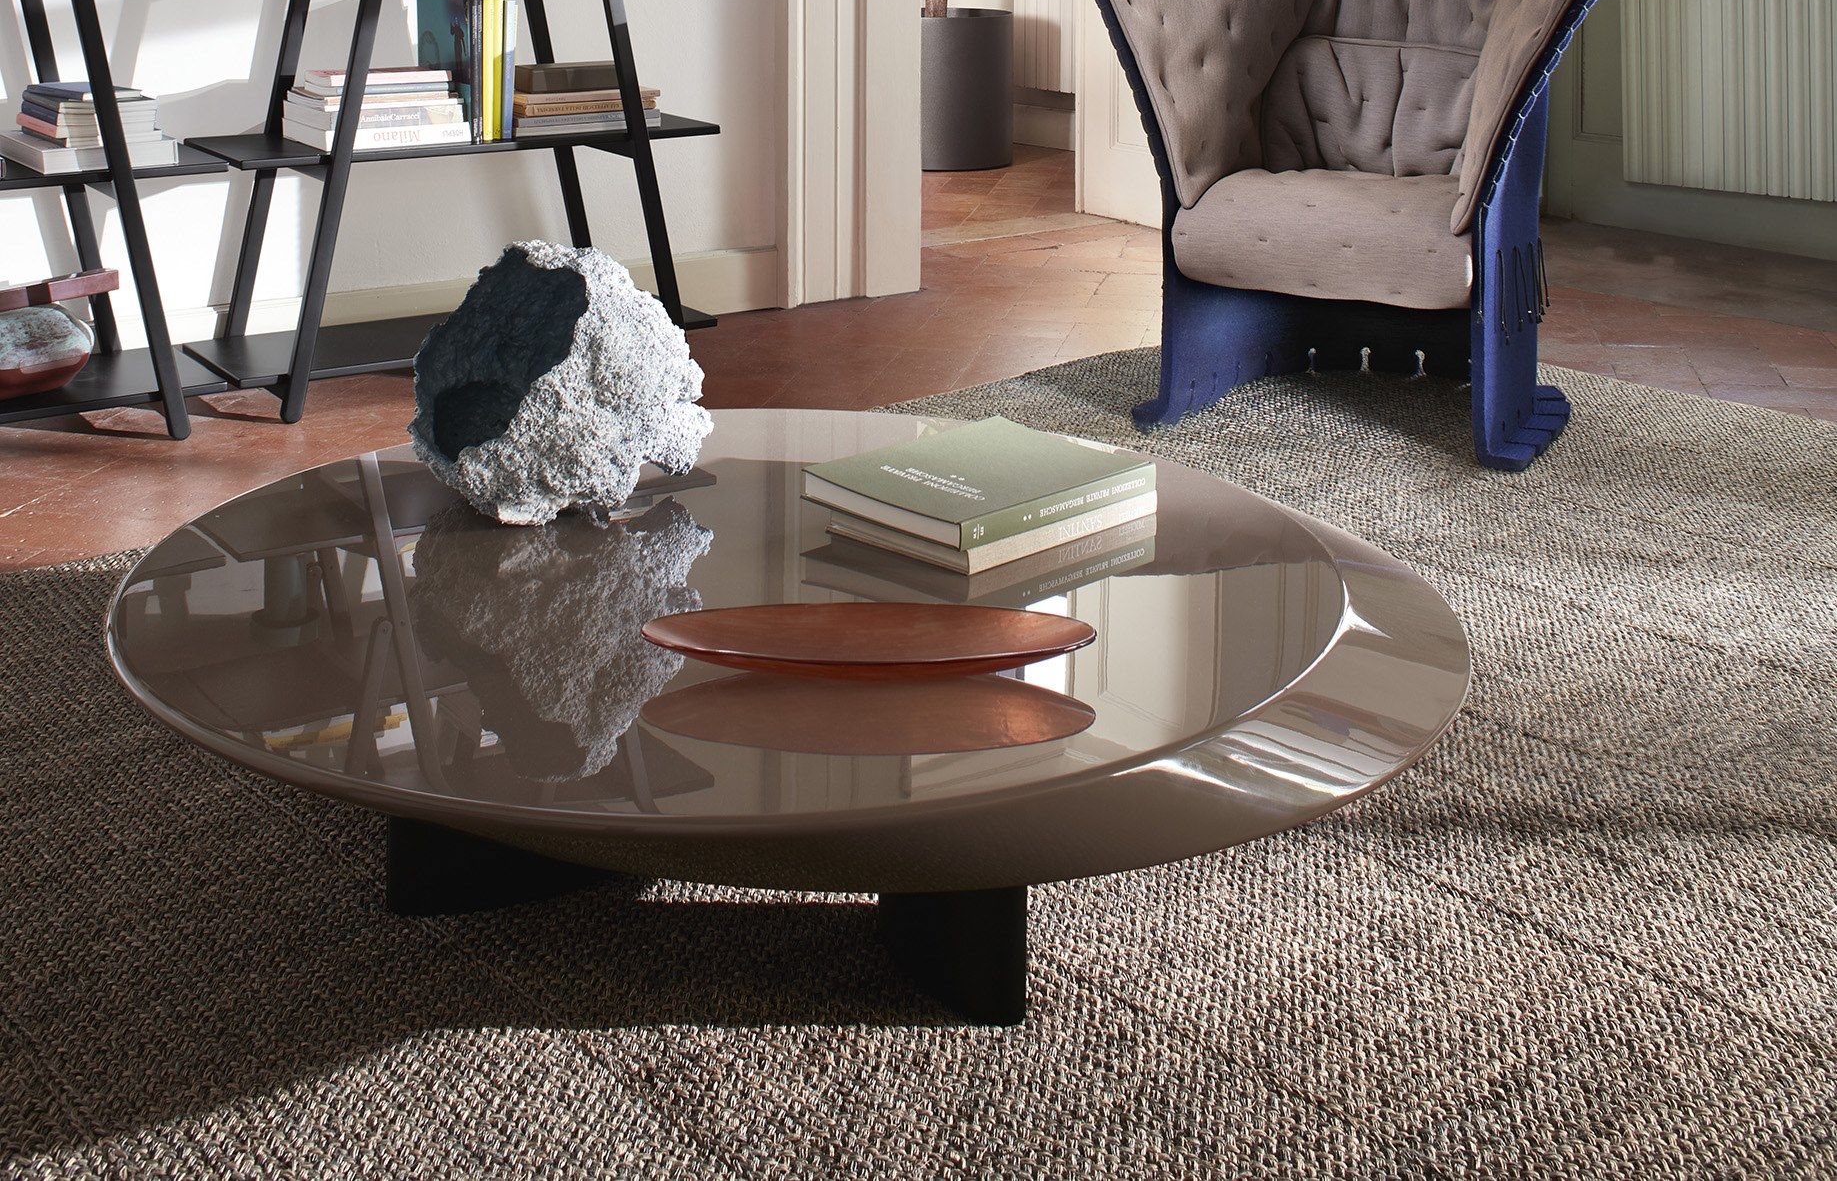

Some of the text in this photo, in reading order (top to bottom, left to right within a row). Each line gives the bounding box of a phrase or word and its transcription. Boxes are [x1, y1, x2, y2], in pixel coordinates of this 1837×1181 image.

[373, 129, 421, 144] Milano
[1039, 477, 1146, 518] COLLEZIONI PRIVATE BERGAMASCHE
